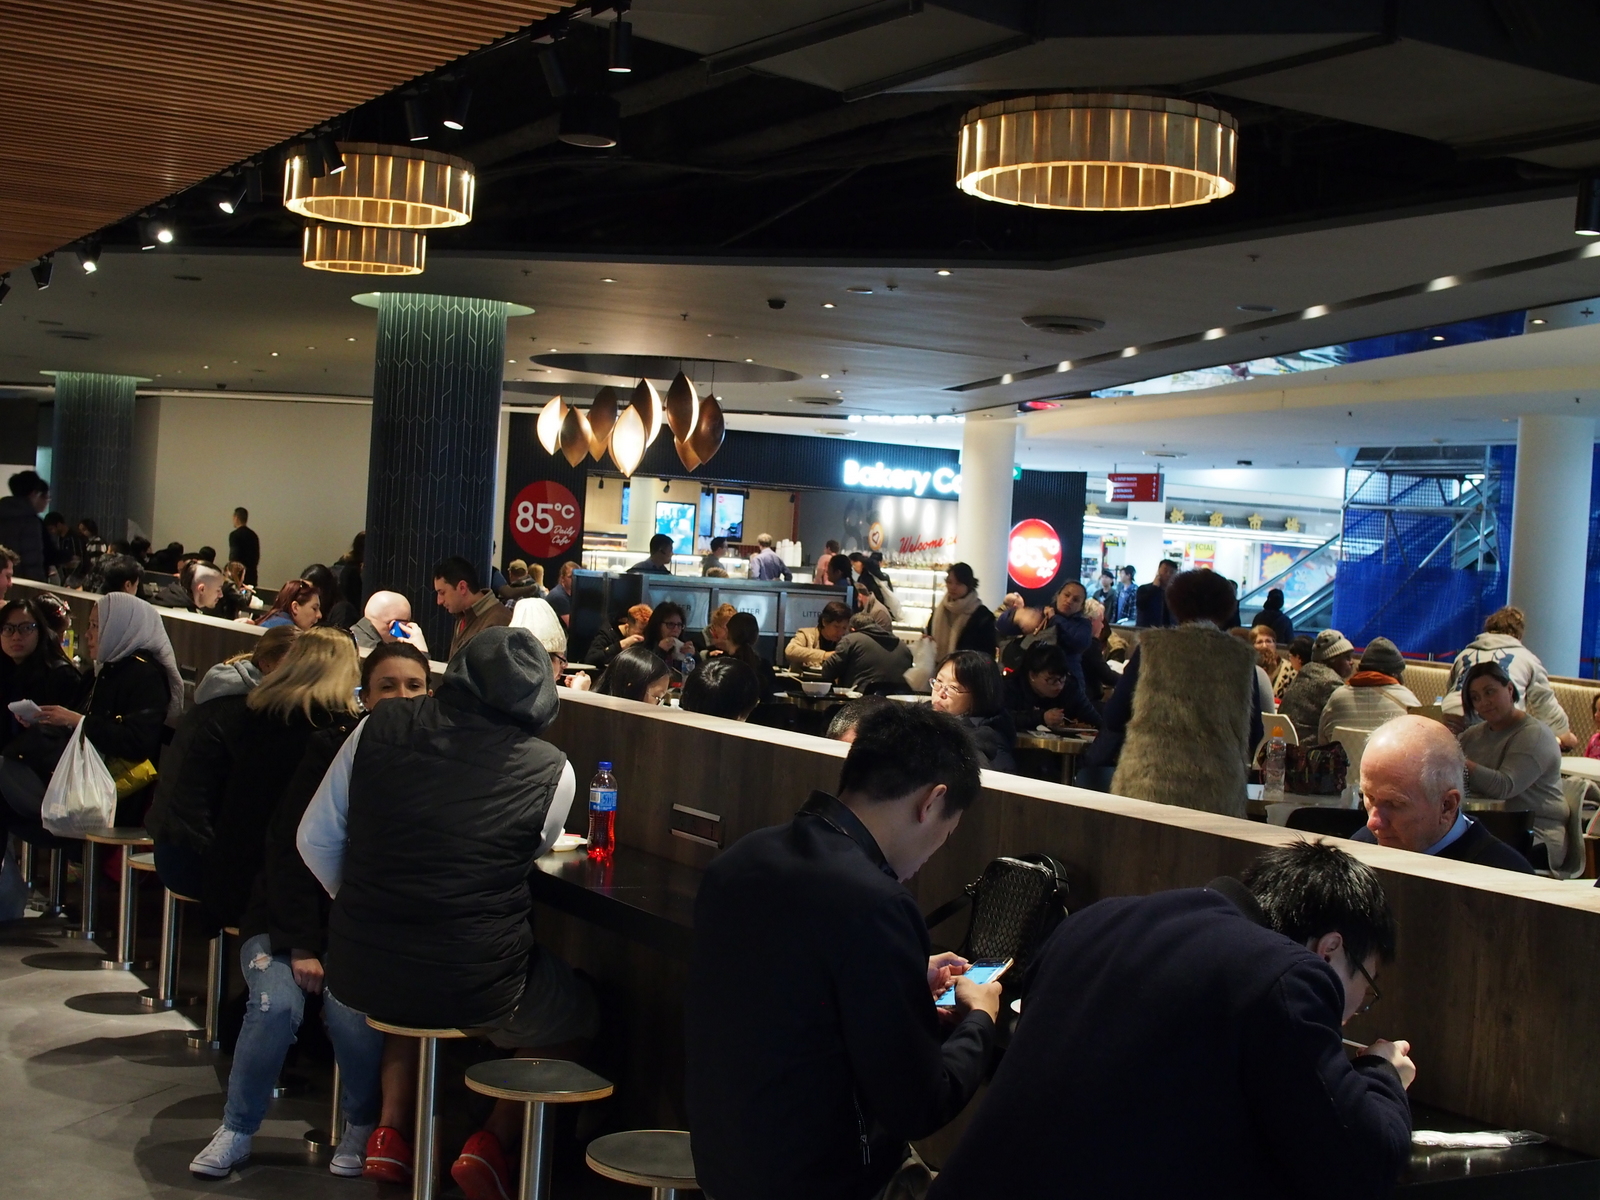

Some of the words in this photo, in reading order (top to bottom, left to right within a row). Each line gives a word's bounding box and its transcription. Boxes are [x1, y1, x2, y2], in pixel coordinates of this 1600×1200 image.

[844, 460, 931, 496] Bakery
[516, 501, 575, 534] 85°C
[553, 525, 576, 537] Daily
[551, 535, 571, 546] Cafe
[899, 534, 944, 554] Welcome
[1187, 542, 1214, 551] SECIAL
[802, 610, 822, 618] LITT
